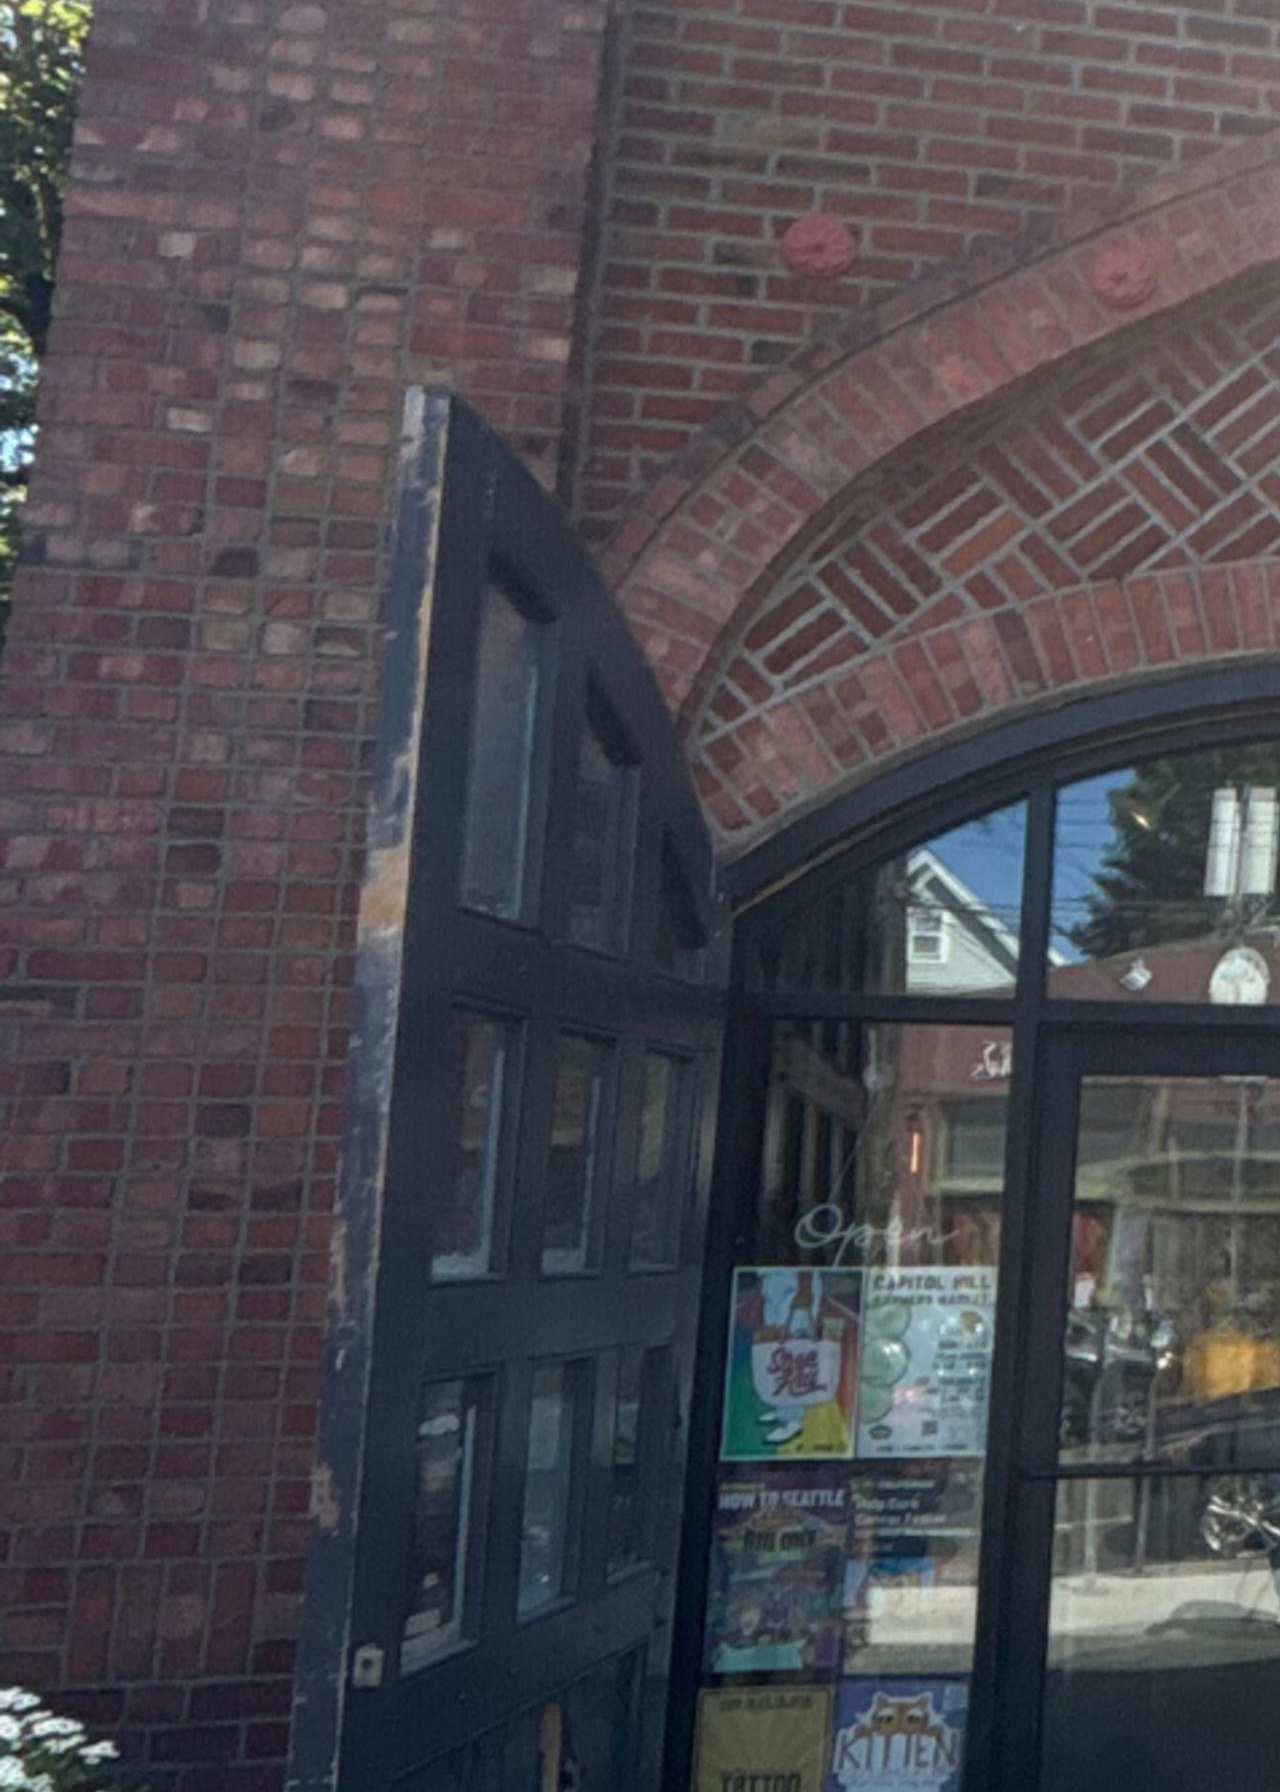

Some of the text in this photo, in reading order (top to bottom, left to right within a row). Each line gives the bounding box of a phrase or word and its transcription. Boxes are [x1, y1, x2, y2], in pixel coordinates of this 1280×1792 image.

[794, 1203, 960, 1268] Open
[873, 1274, 993, 1291] CAPITOL HILL
[719, 1489, 844, 1509] HOW TO SEATTLE
[838, 1731, 956, 1771] KITTEN
